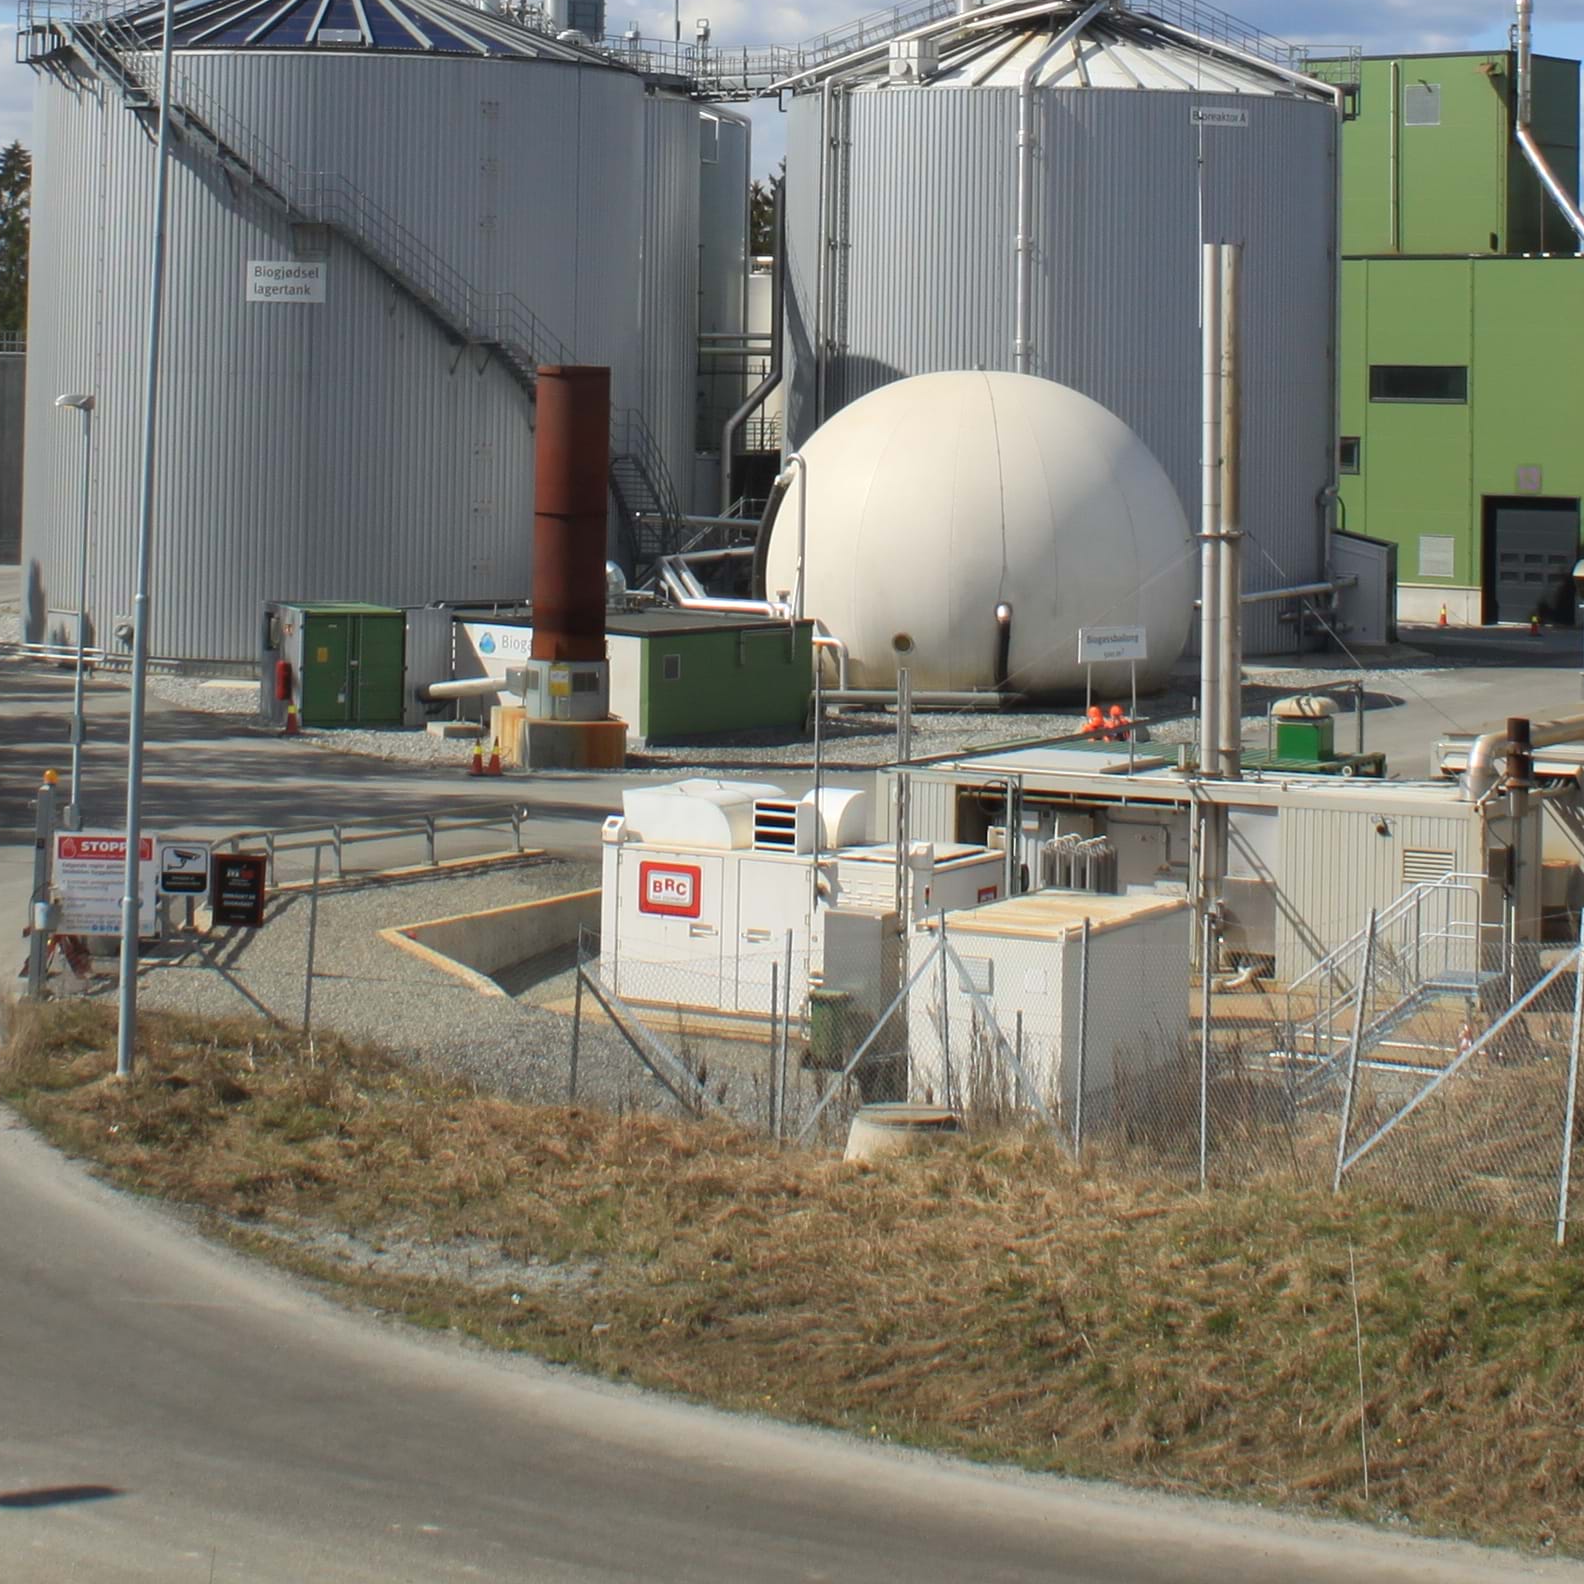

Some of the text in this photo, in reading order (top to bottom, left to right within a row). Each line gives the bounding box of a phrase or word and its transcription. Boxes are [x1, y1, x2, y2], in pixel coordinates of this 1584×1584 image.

[1192, 110, 1246, 122] Boreaktor A
[254, 265, 319, 280] Biogjødsel
[254, 282, 312, 297] lagertank
[653, 878, 687, 896] BRC
